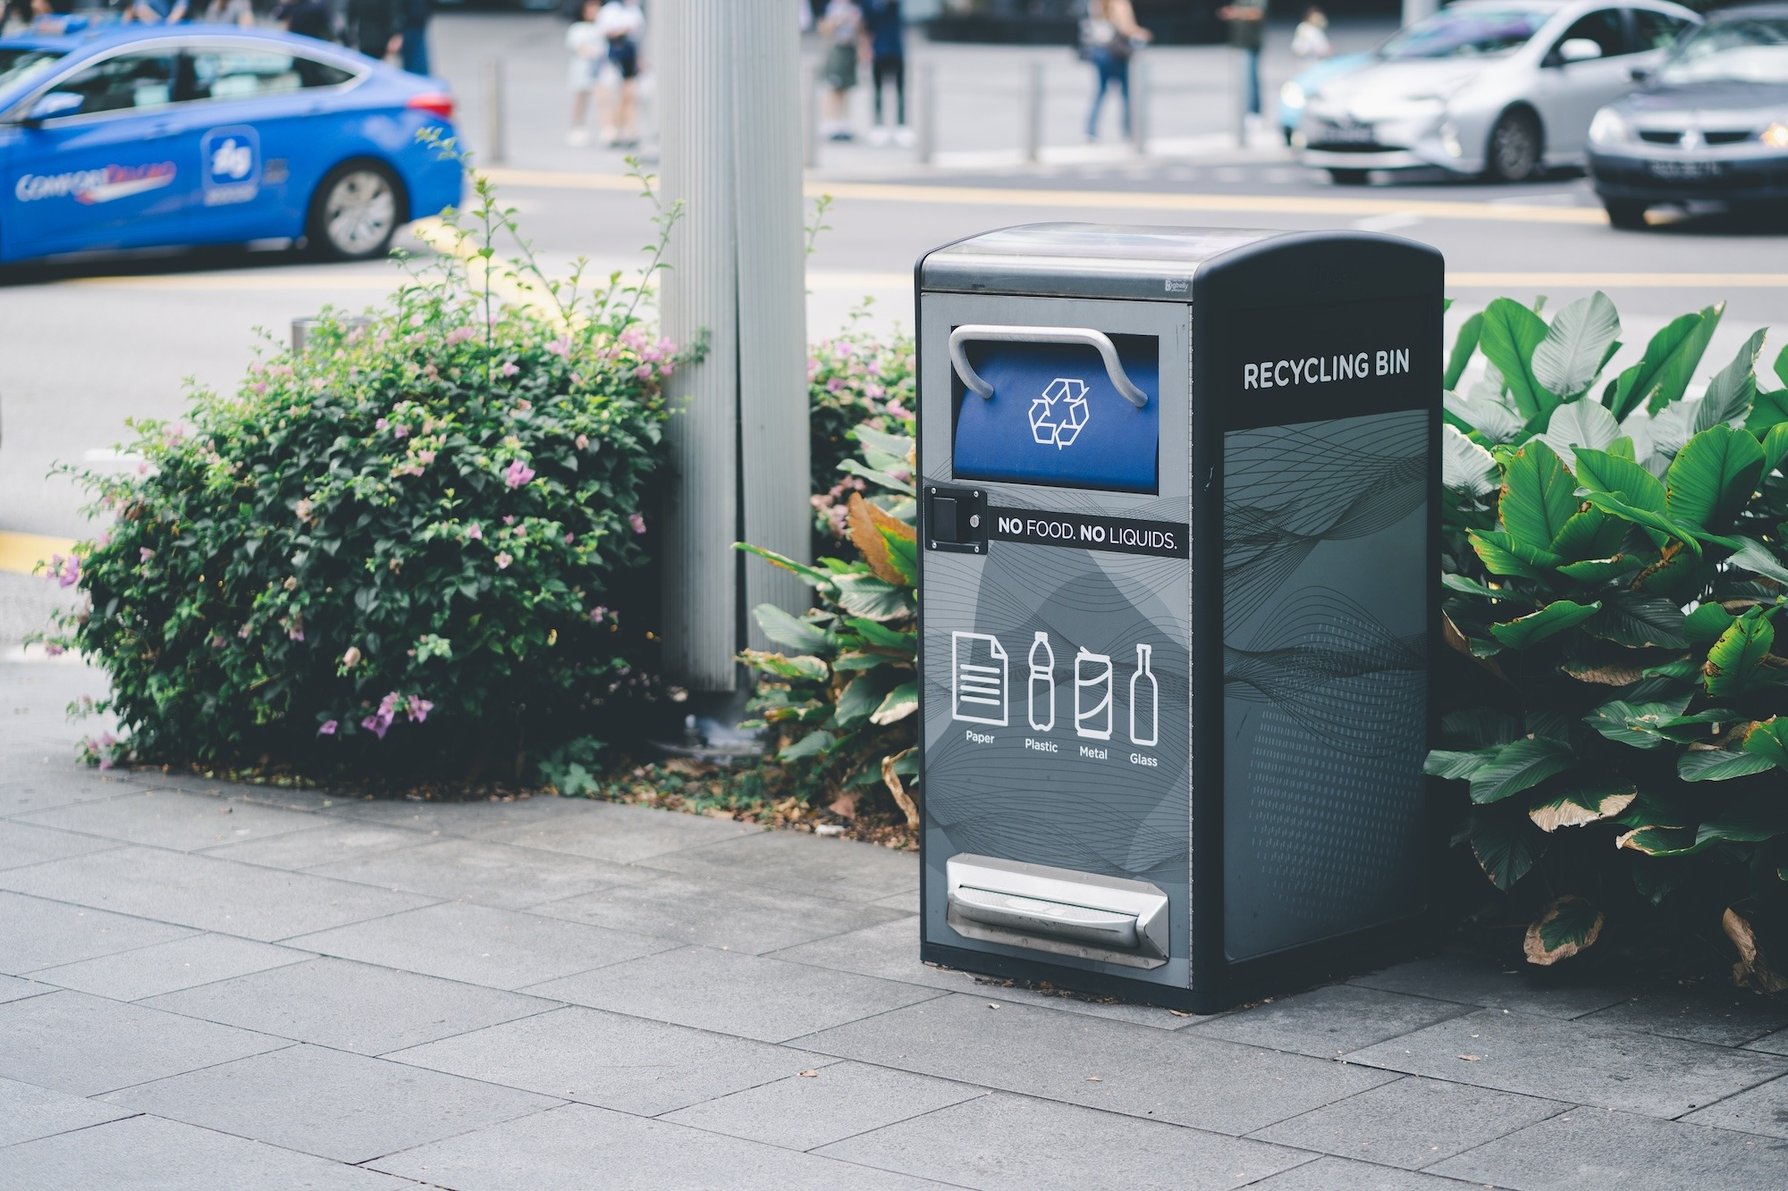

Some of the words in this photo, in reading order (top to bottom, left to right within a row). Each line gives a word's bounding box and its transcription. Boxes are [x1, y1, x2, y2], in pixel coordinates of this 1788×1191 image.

[1244, 352, 1369, 390] RECYCLING
[1375, 348, 1410, 377] BIN
[998, 516, 1023, 535] NO
[1026, 519, 1076, 540] FOOD.
[1080, 524, 1106, 543] NO
[1109, 527, 1178, 550] LIQUIDS.
[965, 729, 995, 745] Paper
[1025, 738, 1059, 753] Plastic
[1079, 745, 1108, 760] Metal
[1129, 752, 1158, 767] Glass
